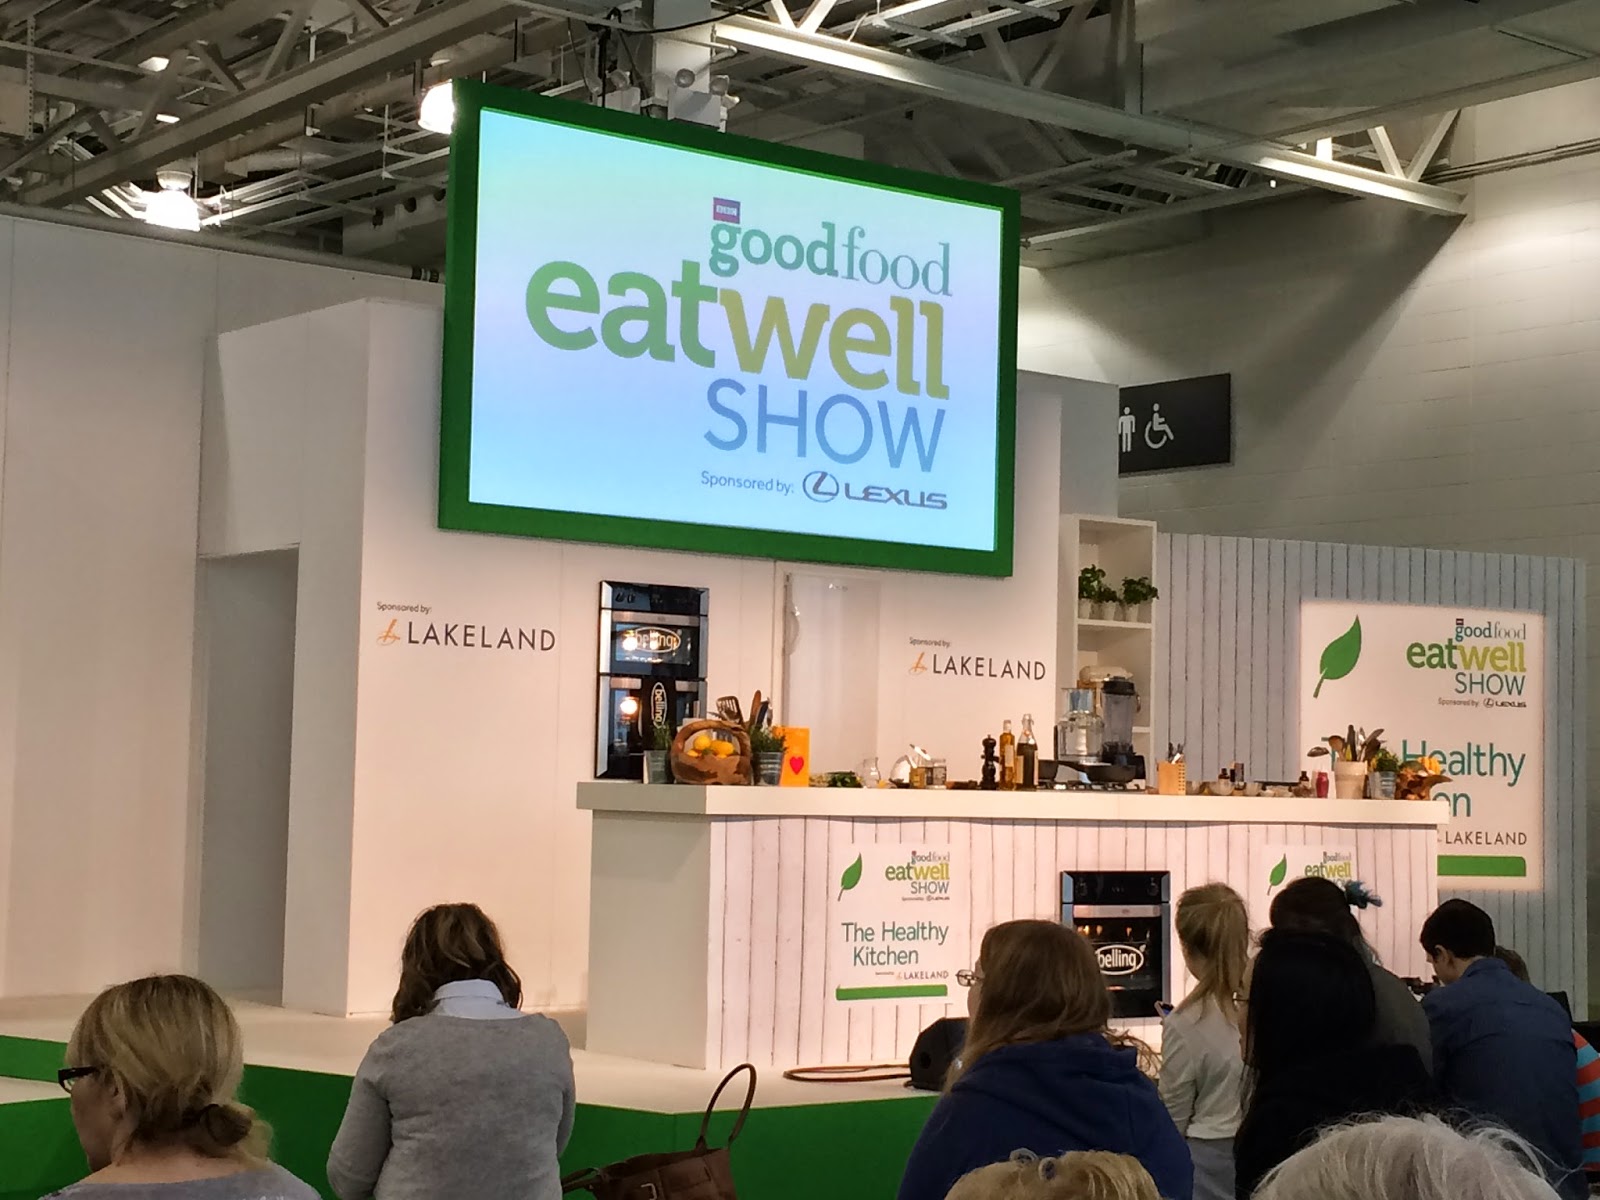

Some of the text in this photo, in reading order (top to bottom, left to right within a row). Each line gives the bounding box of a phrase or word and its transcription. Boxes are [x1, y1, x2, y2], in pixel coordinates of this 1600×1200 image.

[703, 378, 946, 473] SHOW
[701, 470, 774, 492] Sponsored
[776, 479, 795, 496] by:
[844, 482, 948, 510] LEXUS
[376, 601, 420, 614] Sponsored
[408, 620, 556, 652] LAKELAND
[635, 628, 674, 651] beng
[932, 653, 1047, 681] LAKELAND
[1454, 671, 1526, 696] SHOW
[1402, 739, 1526, 787] Healthy
[1444, 830, 1528, 846] LAKELAND
[910, 880, 950, 895] SHOW
[841, 921, 950, 946] The Healthy
[853, 945, 919, 967] Kitchen
[1098, 948, 1137, 970] belling
[903, 970, 950, 980] LAKELAND
